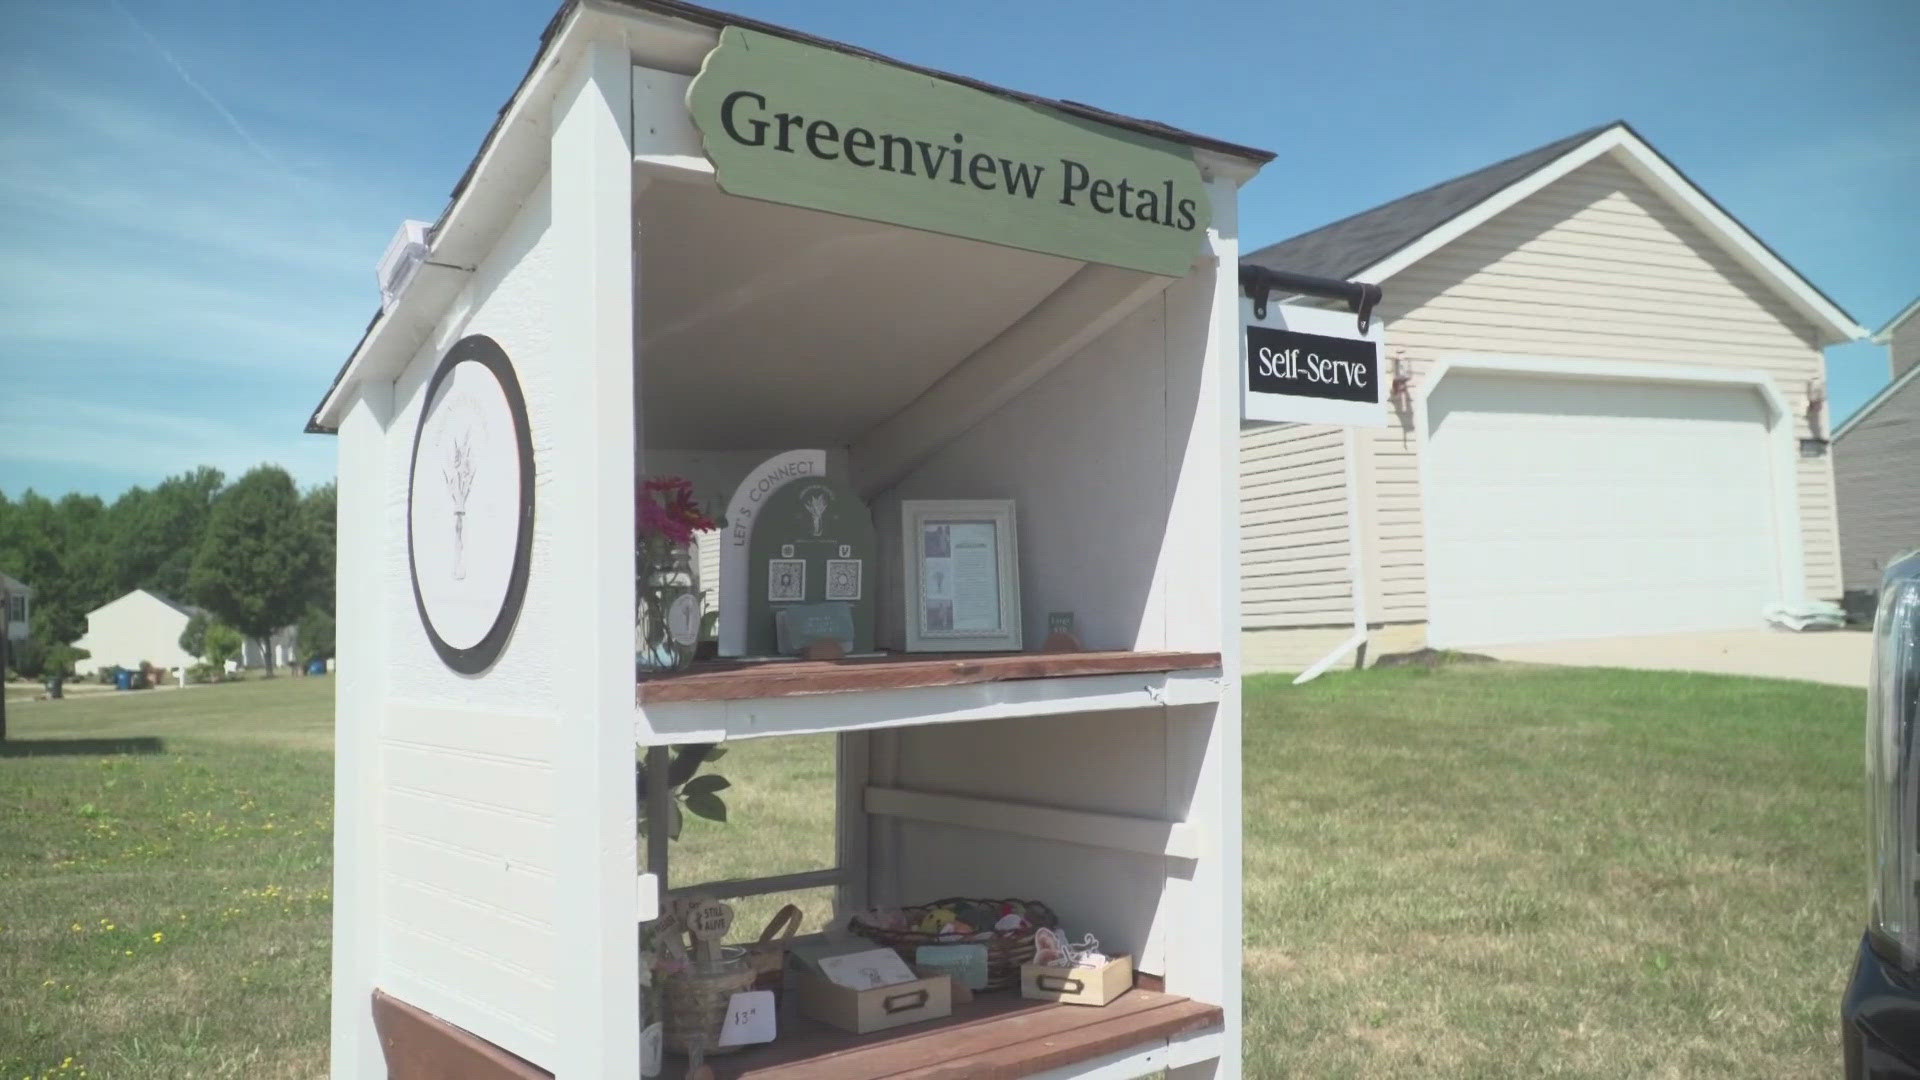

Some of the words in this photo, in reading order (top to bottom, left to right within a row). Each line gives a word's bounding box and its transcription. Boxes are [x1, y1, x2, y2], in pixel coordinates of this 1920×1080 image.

[720, 91, 1045, 199] Greenview
[1059, 159, 1197, 231] Petals
[1258, 346, 1368, 388] Self-Serve
[733, 506, 752, 547] LET'S
[749, 461, 815, 503] CONNECT
